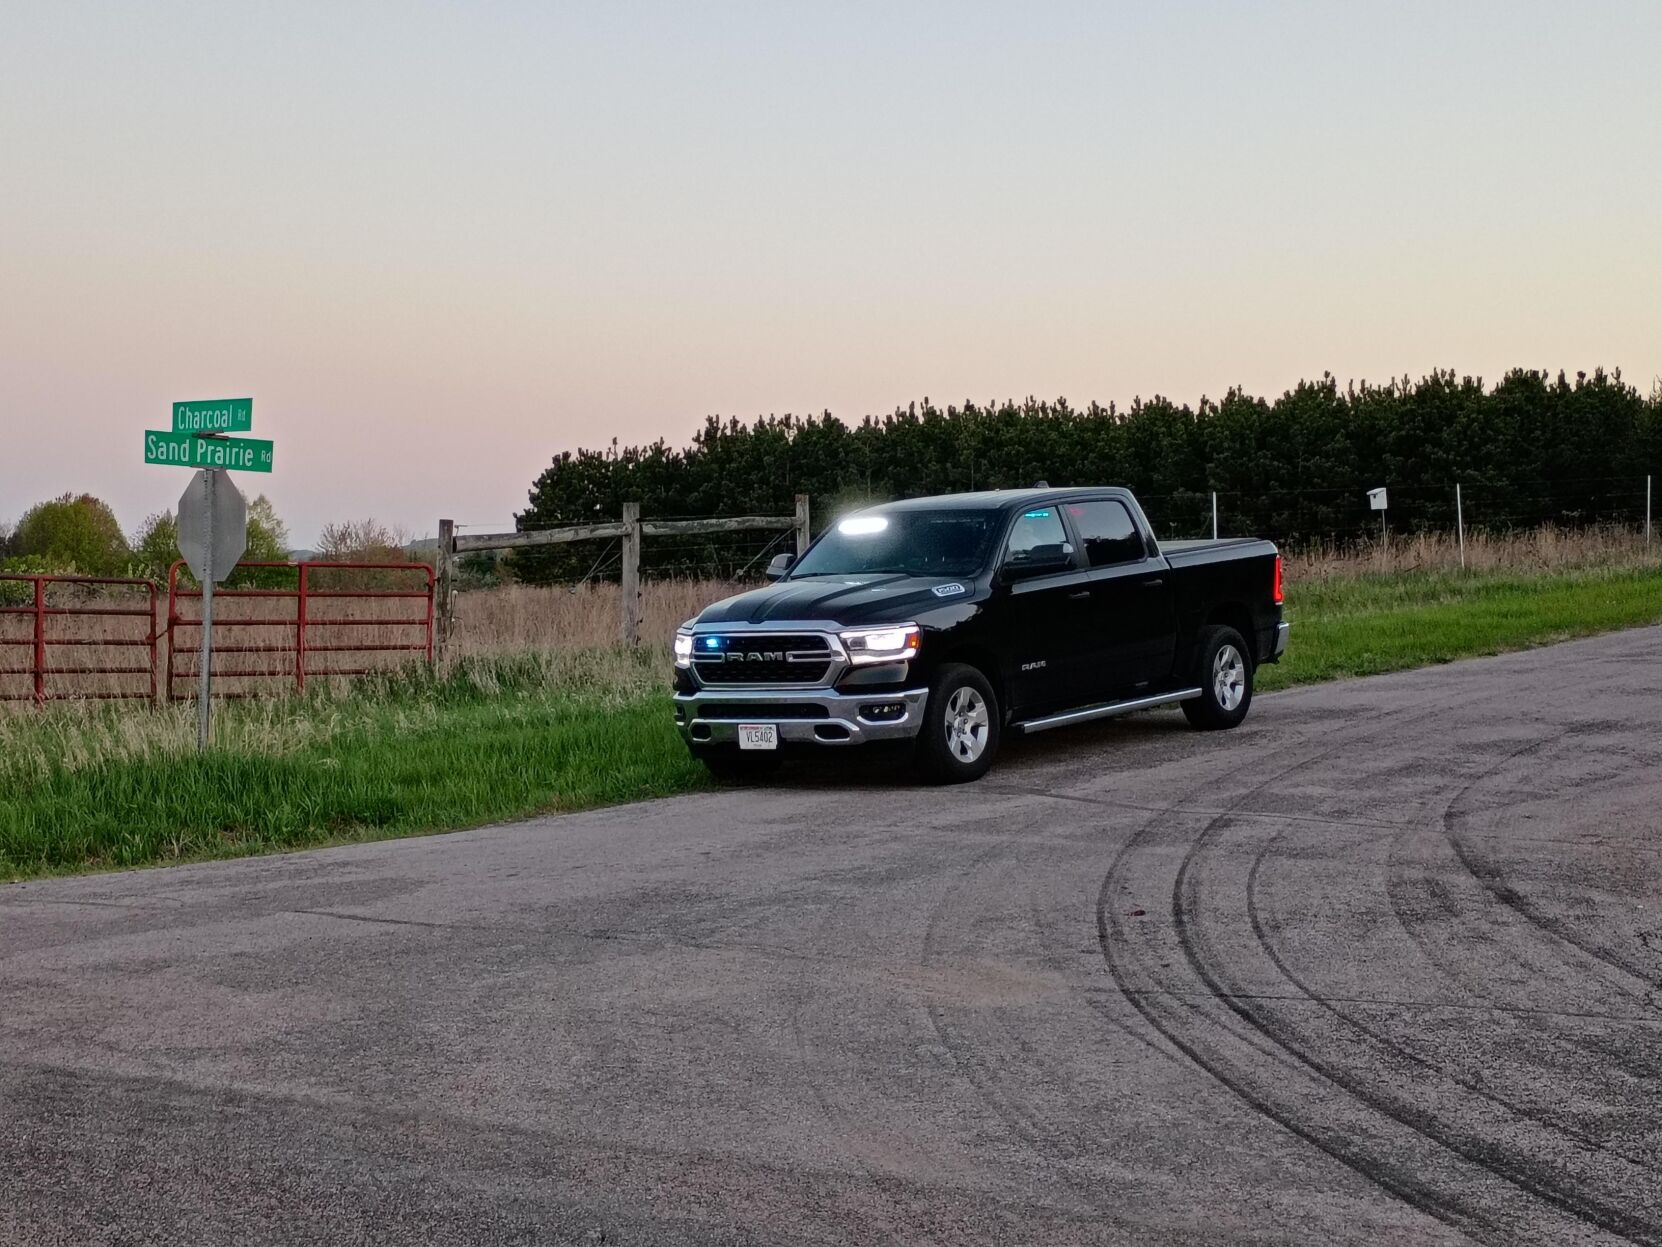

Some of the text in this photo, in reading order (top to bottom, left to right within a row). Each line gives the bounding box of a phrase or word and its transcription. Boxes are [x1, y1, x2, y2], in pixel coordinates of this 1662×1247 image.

[178, 404, 246, 429] Charcoal Rd
[147, 435, 271, 467] Sand Prairie Rd
[726, 652, 783, 662] RAM
